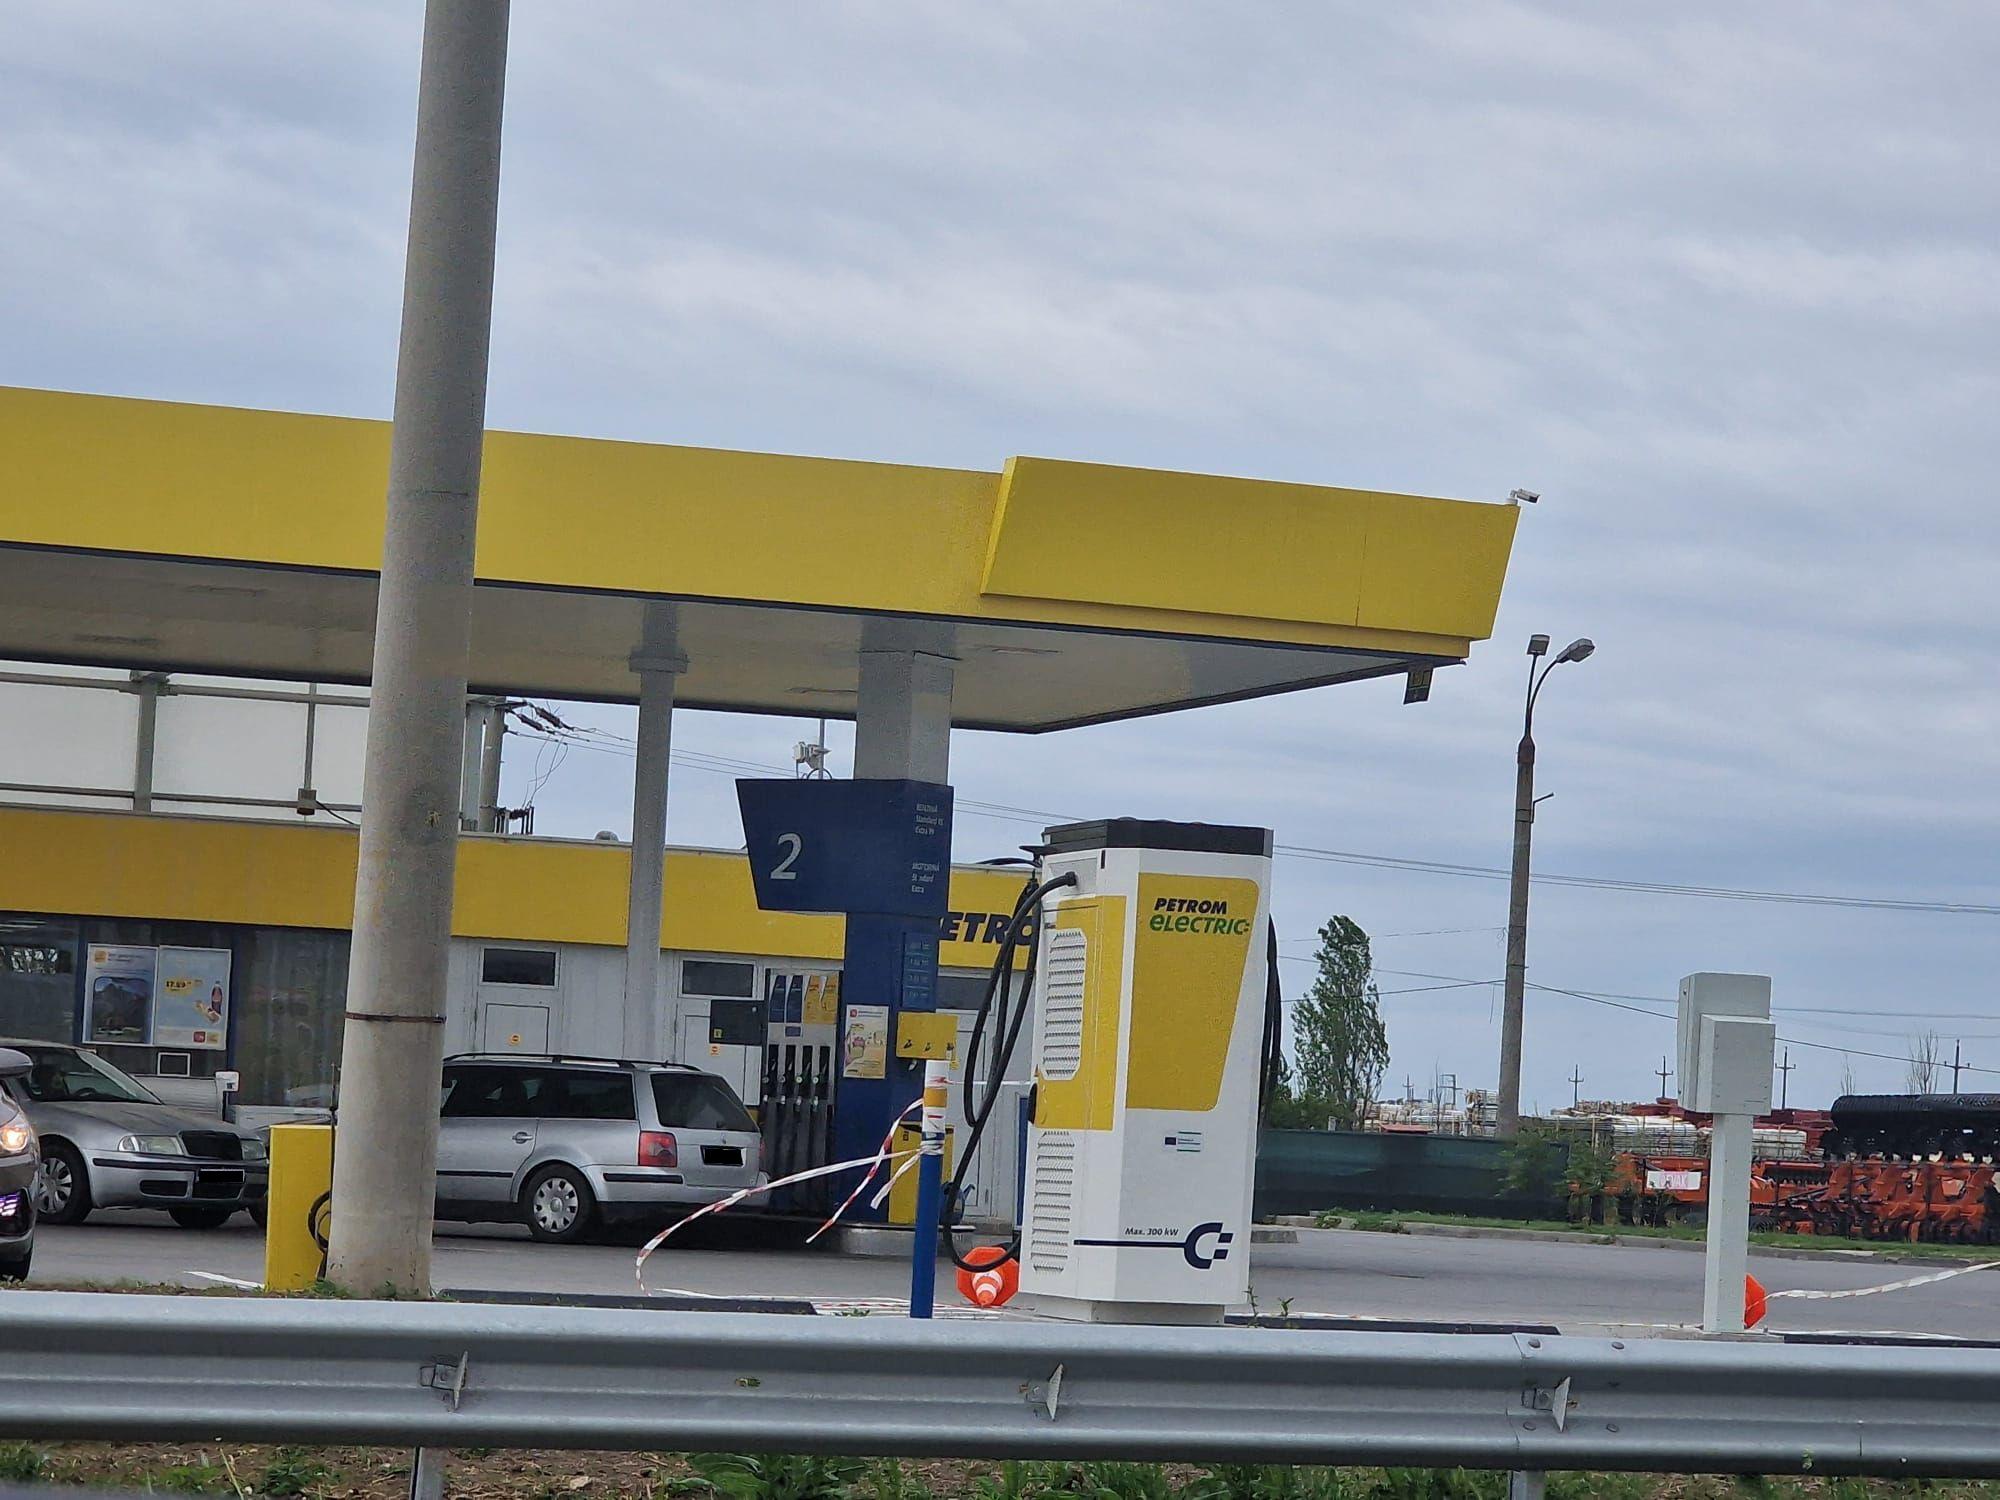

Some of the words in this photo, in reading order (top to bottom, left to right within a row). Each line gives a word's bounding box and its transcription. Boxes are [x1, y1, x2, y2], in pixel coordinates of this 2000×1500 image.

[770, 832, 802, 880] 2
[1154, 898, 1227, 914] PETROM
[1124, 1227, 1146, 1236] Max.
[1146, 1227, 1163, 1236] 300
[1164, 1227, 1179, 1237] kW
